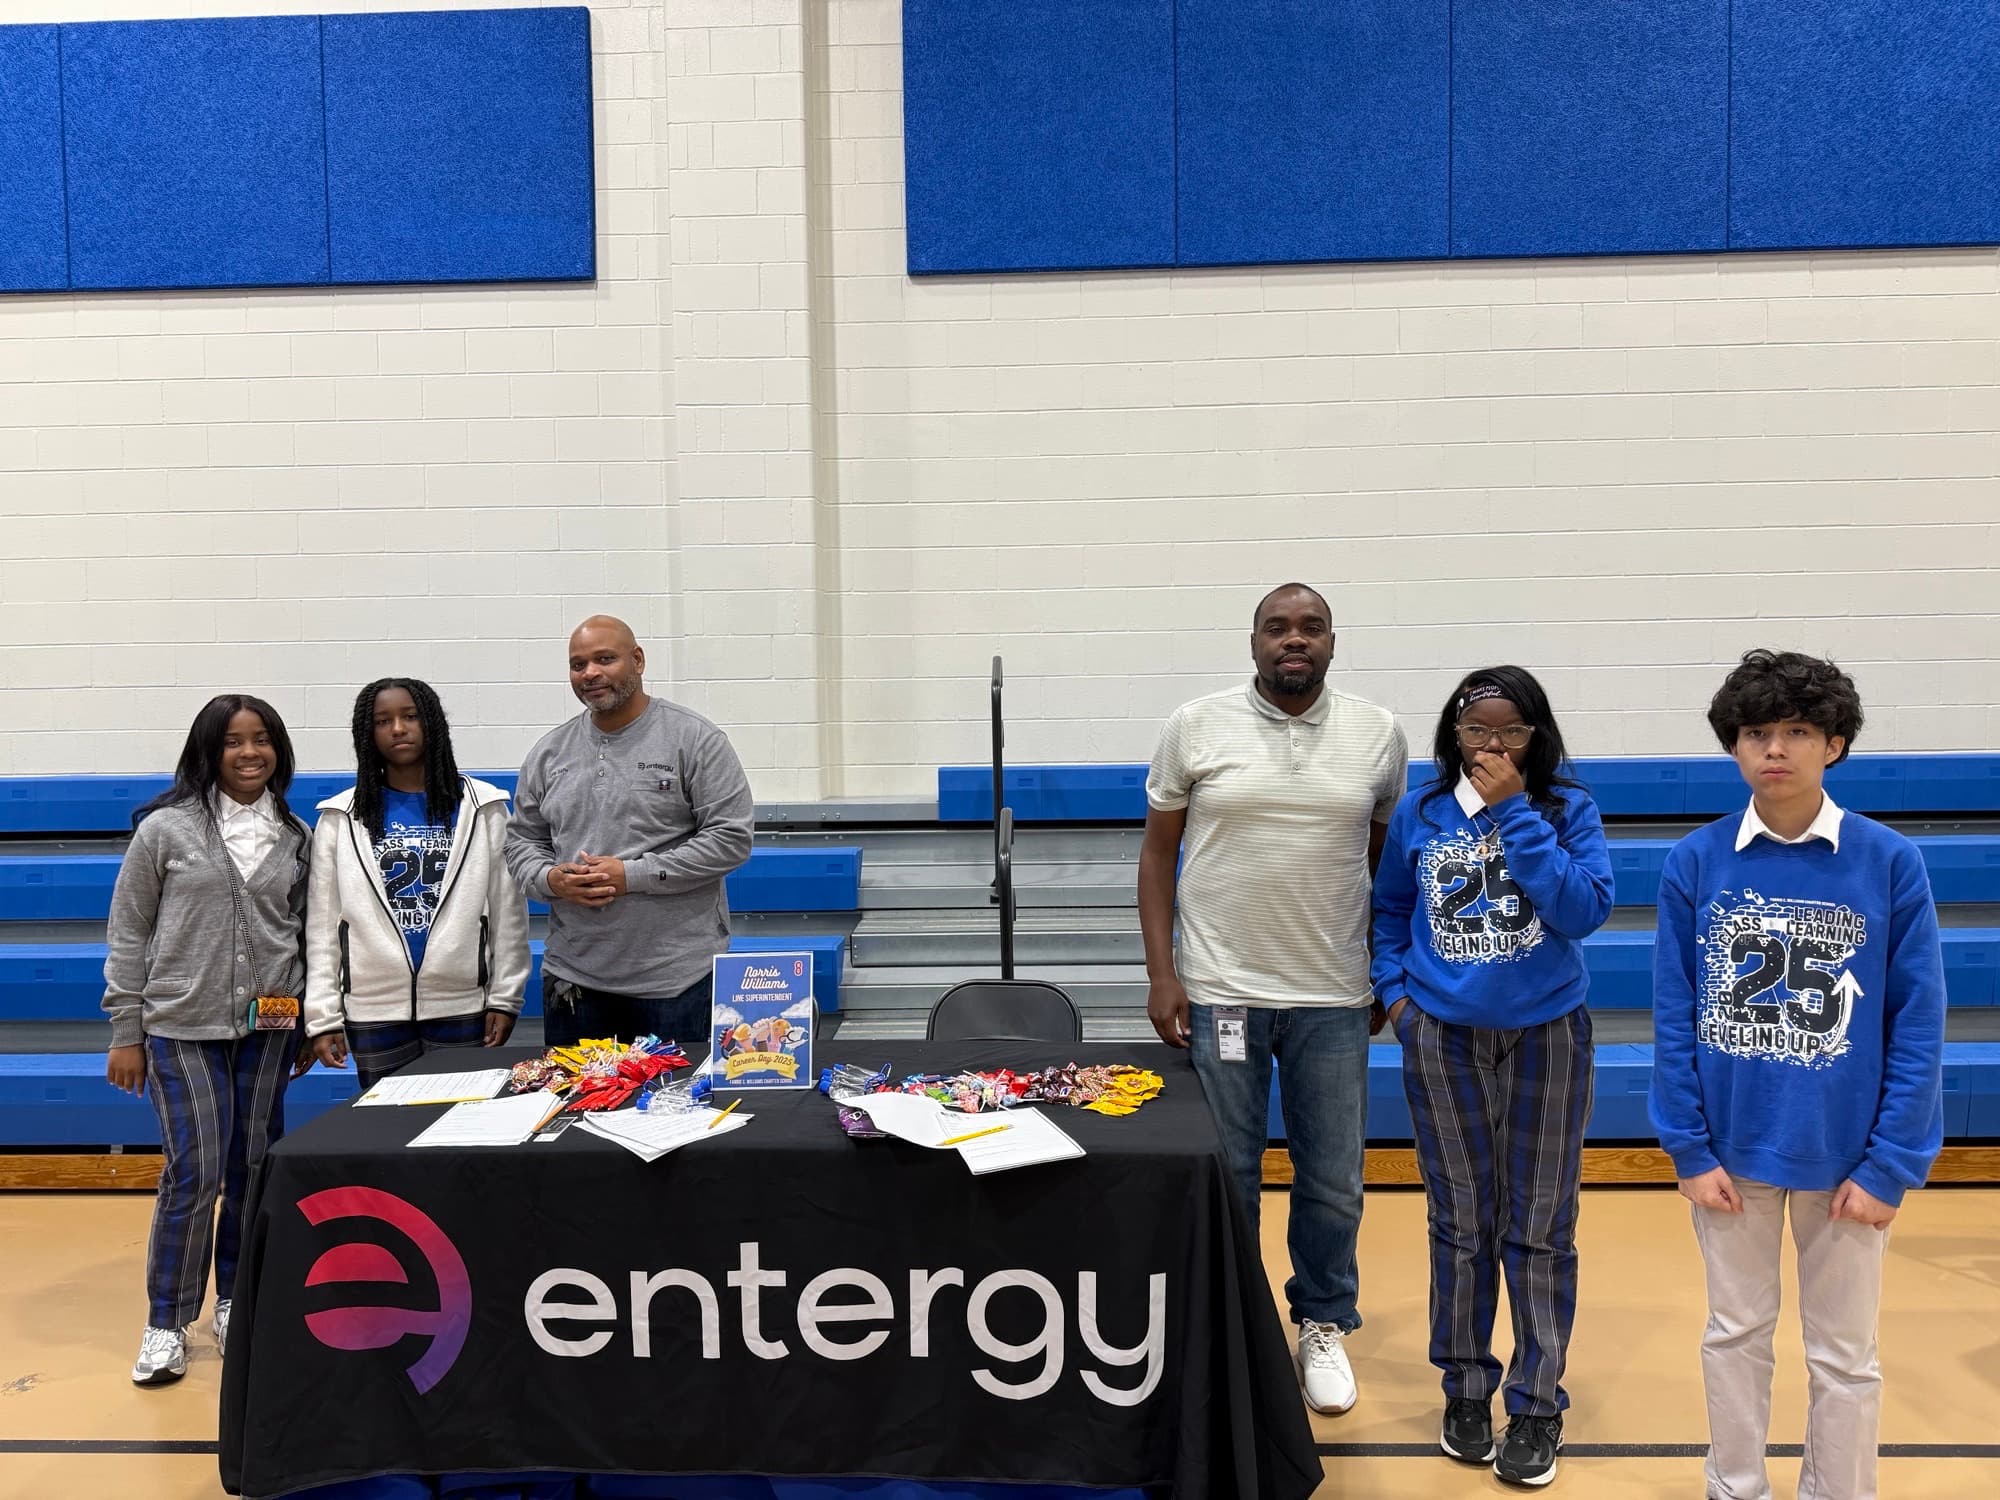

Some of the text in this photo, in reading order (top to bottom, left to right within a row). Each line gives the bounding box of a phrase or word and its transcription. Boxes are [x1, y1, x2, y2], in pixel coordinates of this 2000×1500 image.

[1429, 849, 1470, 870] CLASS
[1436, 854, 1535, 934] 25
[1794, 906, 1865, 929] LEADING
[1434, 933, 1519, 954] VELING UP
[1718, 917, 1762, 947] CLASS
[1786, 920, 1866, 945] LEARNING
[744, 965, 781, 978] Norris
[740, 978, 789, 990] Williams
[1731, 934, 1842, 1034] 25
[1698, 1023, 1821, 1055] LEVELING UP
[732, 1055, 793, 1067] Career Day 2025
[523, 1241, 1167, 1407] entergy
